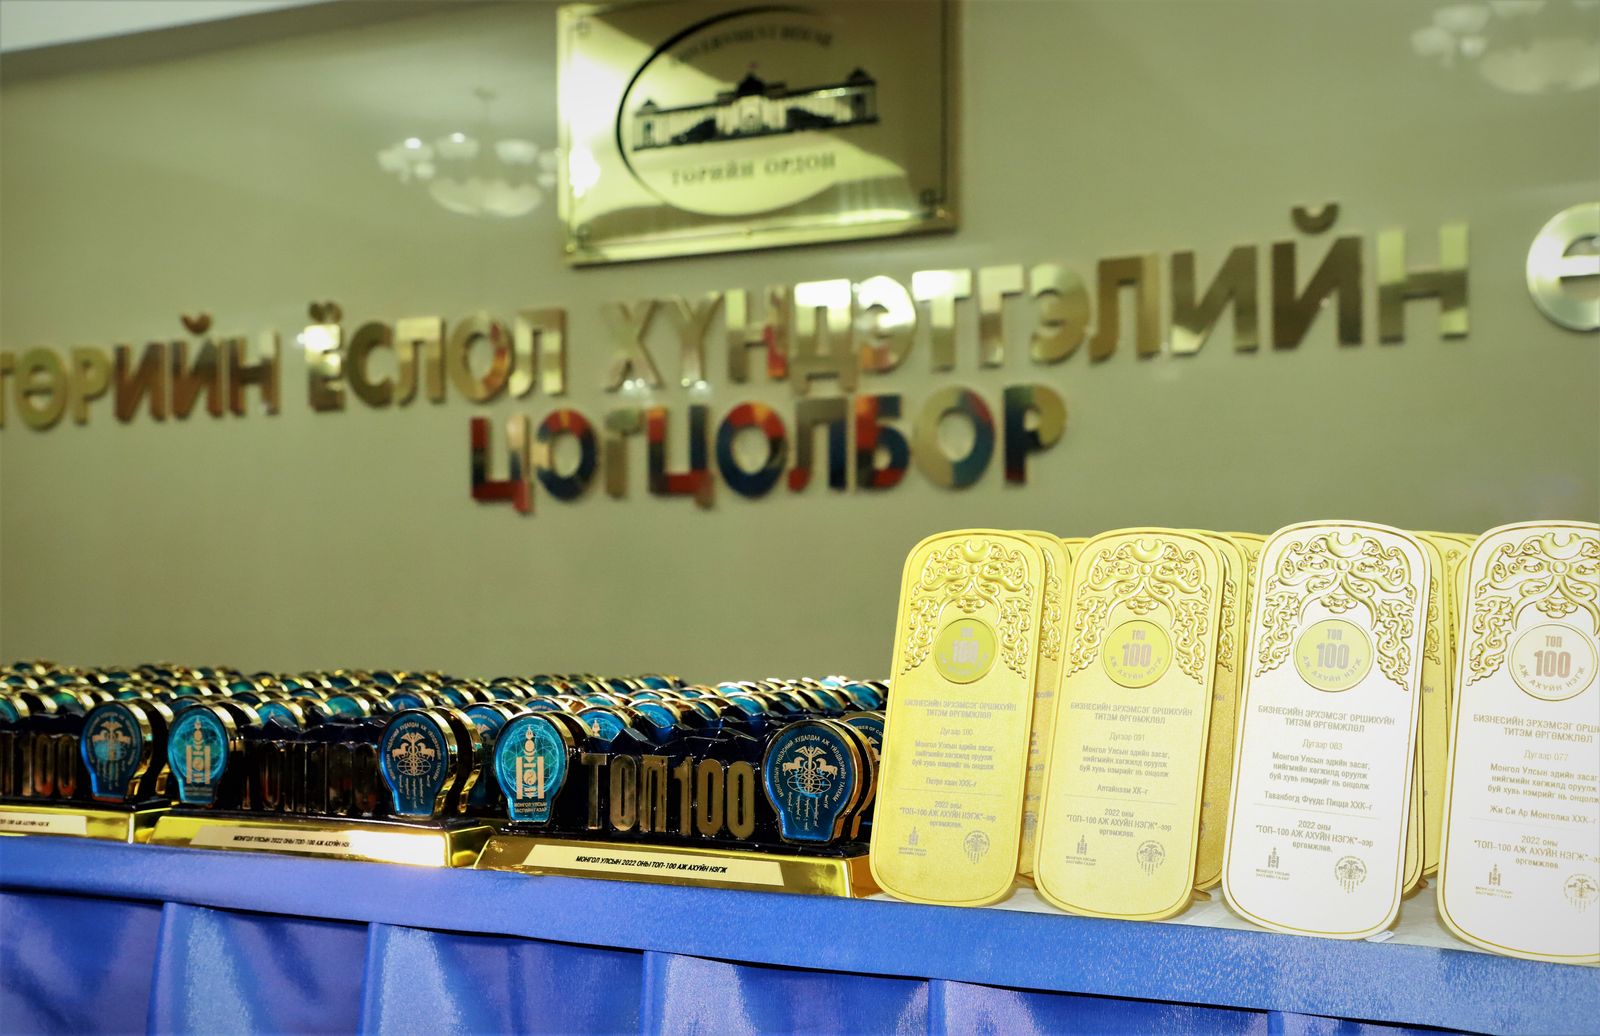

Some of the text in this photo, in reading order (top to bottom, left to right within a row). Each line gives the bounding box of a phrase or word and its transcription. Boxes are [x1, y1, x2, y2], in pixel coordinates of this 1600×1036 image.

[302, 301, 568, 414] ЁСЛОЛ
[604, 202, 1470, 394] ХҮНДЭТГЭЛИЙН
[469, 384, 1068, 515] ЦОГЦОЛБОР
[1327, 628, 1343, 641] ТОП
[1545, 635, 1563, 648] ТОП
[1122, 643, 1152, 667] 100
[1316, 643, 1350, 669] 100
[1533, 650, 1571, 678] 100
[1518, 663, 1586, 692] АЖ АХУЙН НЭГЖ
[1258, 704, 1395, 726] БИЗНЕСИЙН ЭРХЭМСЭГ ОРШИХУЙН
[1473, 713, 1525, 727] БИЗНЕСИЙН
[1526, 719, 1573, 731] ЭРХЭМСЭГ
[1285, 717, 1365, 733] ТИТЭМ ӨРГӨМЖЛӨЛ
[1302, 738, 1343, 750] Дугаар 083
[1504, 727, 1593, 743] ТИТЭМ ӨРГӨМЖЛӨЛ
[1272, 751, 1299, 762] Монгол
[1300, 754, 1324, 765] Улсын
[1325, 758, 1348, 769] эдийн
[1523, 749, 1569, 761] Дугаар 077
[1273, 763, 1368, 781] нийгмийн хөгжилд оруулж
[1490, 763, 1520, 773] Монгол
[1522, 766, 1548, 776] Улсын
[1550, 769, 1575, 780] эдийн
[1269, 772, 1370, 791] буй хувь нэмрийг нь онцолж
[1491, 774, 1597, 794] нийгмийн хөгжилд оруулж
[581, 752, 668, 833] ТОП
[673, 756, 756, 840] 100
[1488, 784, 1501, 794] буй
[1503, 787, 1521, 797] хувь
[1522, 788, 1555, 800] нэмрийг
[1557, 793, 1568, 801] нь
[1489, 805, 1503, 814] Жи
[1505, 806, 1516, 816] Си
[1518, 808, 1528, 818] Ар
[1298, 819, 1332, 831] 2022 оны
[1290, 829, 1304, 839] АЖ
[1305, 829, 1331, 842] АХУЙН
[1521, 835, 1559, 848] 2022 оны
[1513, 845, 1527, 855] АЖ
[1529, 847, 1558, 859] АХУЙН
[576, 855, 728, 874] МОНГОЛ УЛСЫН 2022 ОНЫ ТОП-100 АЖ АХУЙН НЭГЖ
